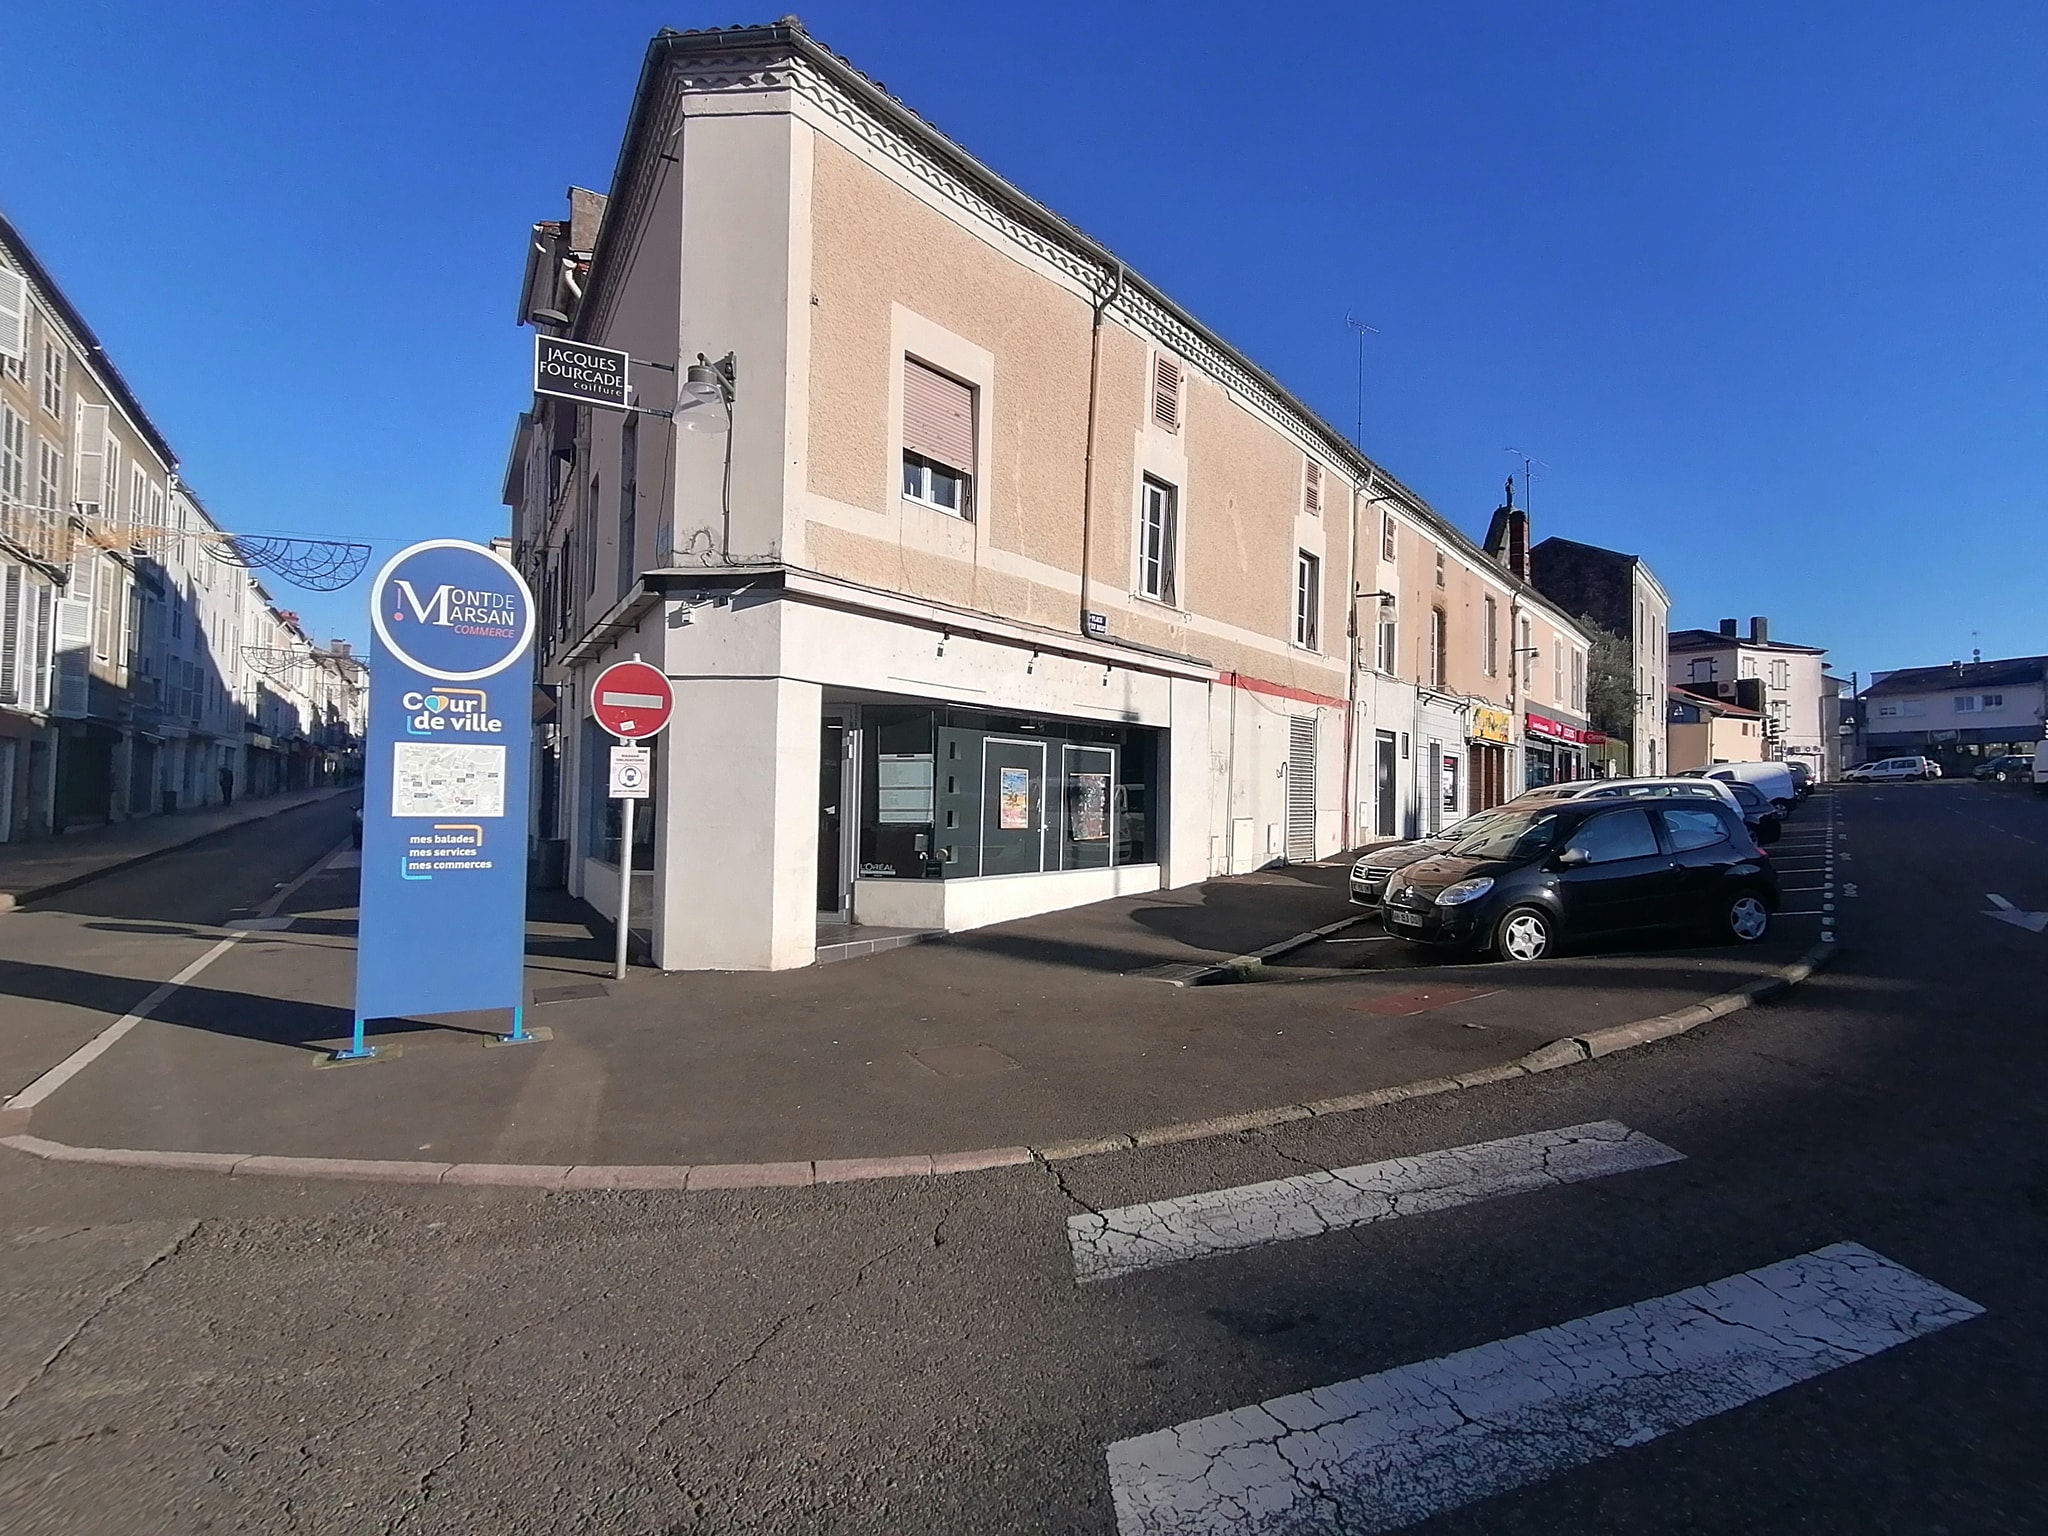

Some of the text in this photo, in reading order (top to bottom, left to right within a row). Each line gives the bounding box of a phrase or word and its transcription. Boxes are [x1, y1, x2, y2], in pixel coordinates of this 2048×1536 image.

[548, 347, 616, 372] JACQUES
[540, 361, 623, 387] FOURCADE
[573, 382, 622, 396] coiffure
[454, 625, 515, 638] COMMERCE
[414, 711, 502, 732] de ville
[410, 835, 475, 844] mes balades
[409, 847, 477, 857] mes services
[409, 861, 493, 870] mes commerces
